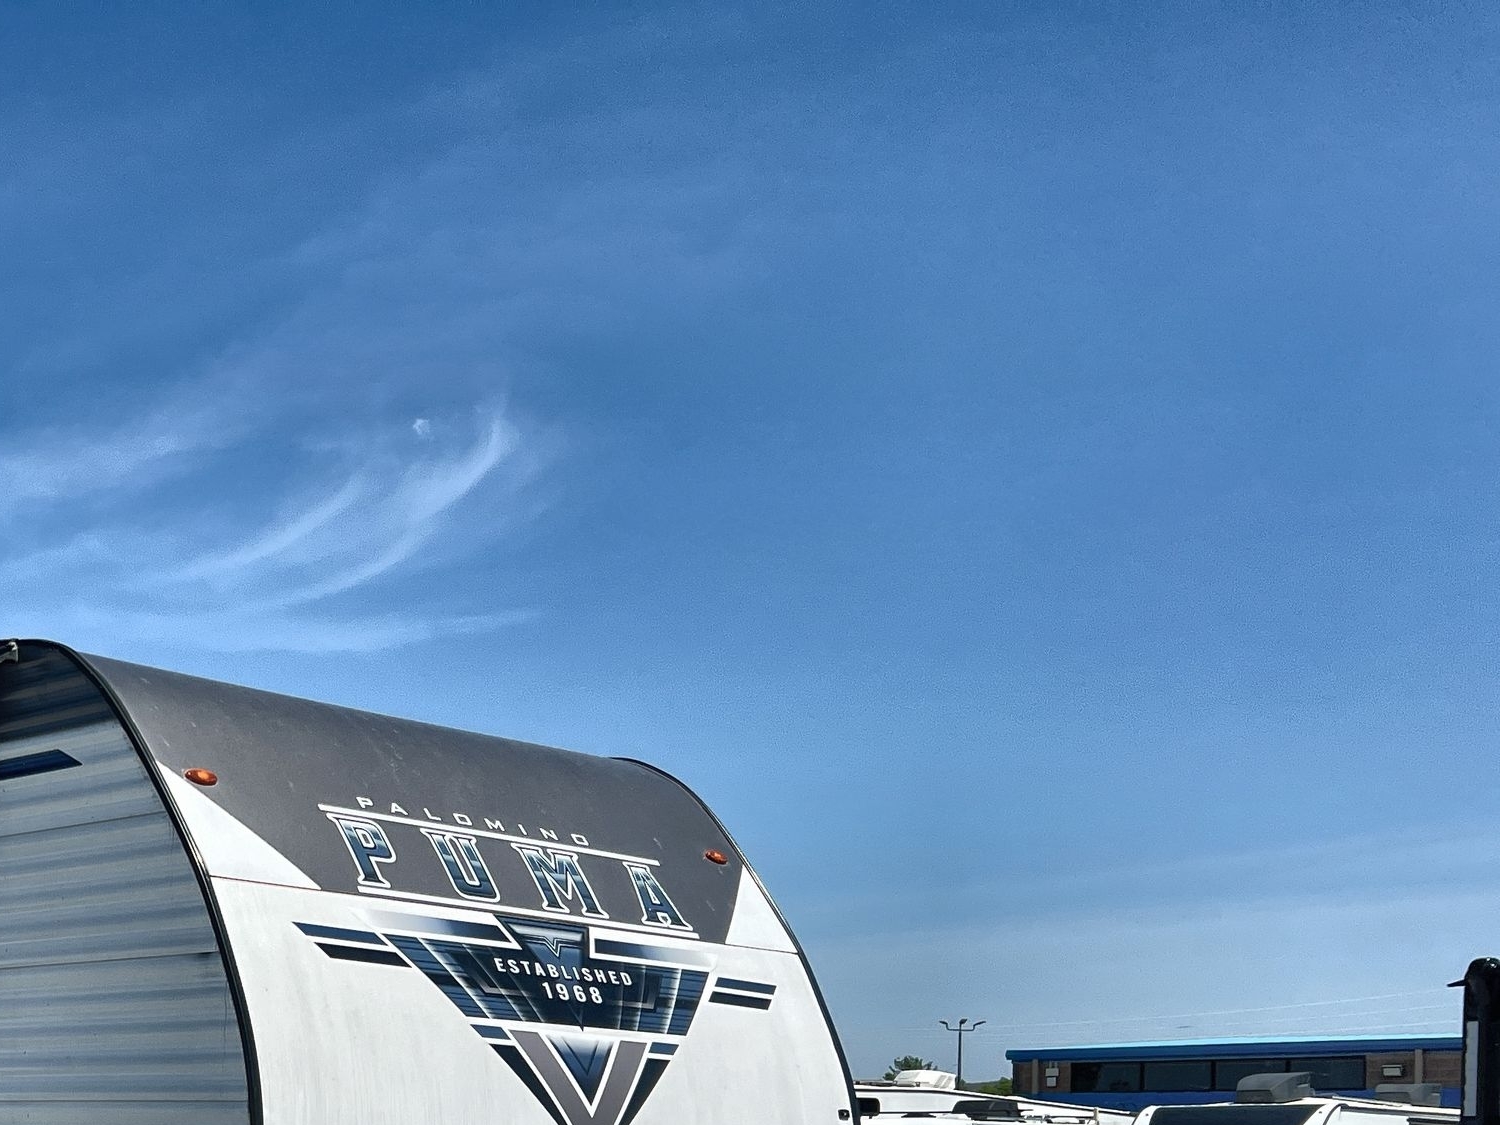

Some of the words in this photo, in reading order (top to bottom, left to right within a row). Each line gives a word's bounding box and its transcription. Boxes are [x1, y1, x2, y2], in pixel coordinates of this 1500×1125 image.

[356, 796, 590, 847] PALOMINO
[326, 811, 694, 932] PUMA
[493, 956, 633, 987] ESTABLISHED
[541, 981, 604, 1005] 1968
